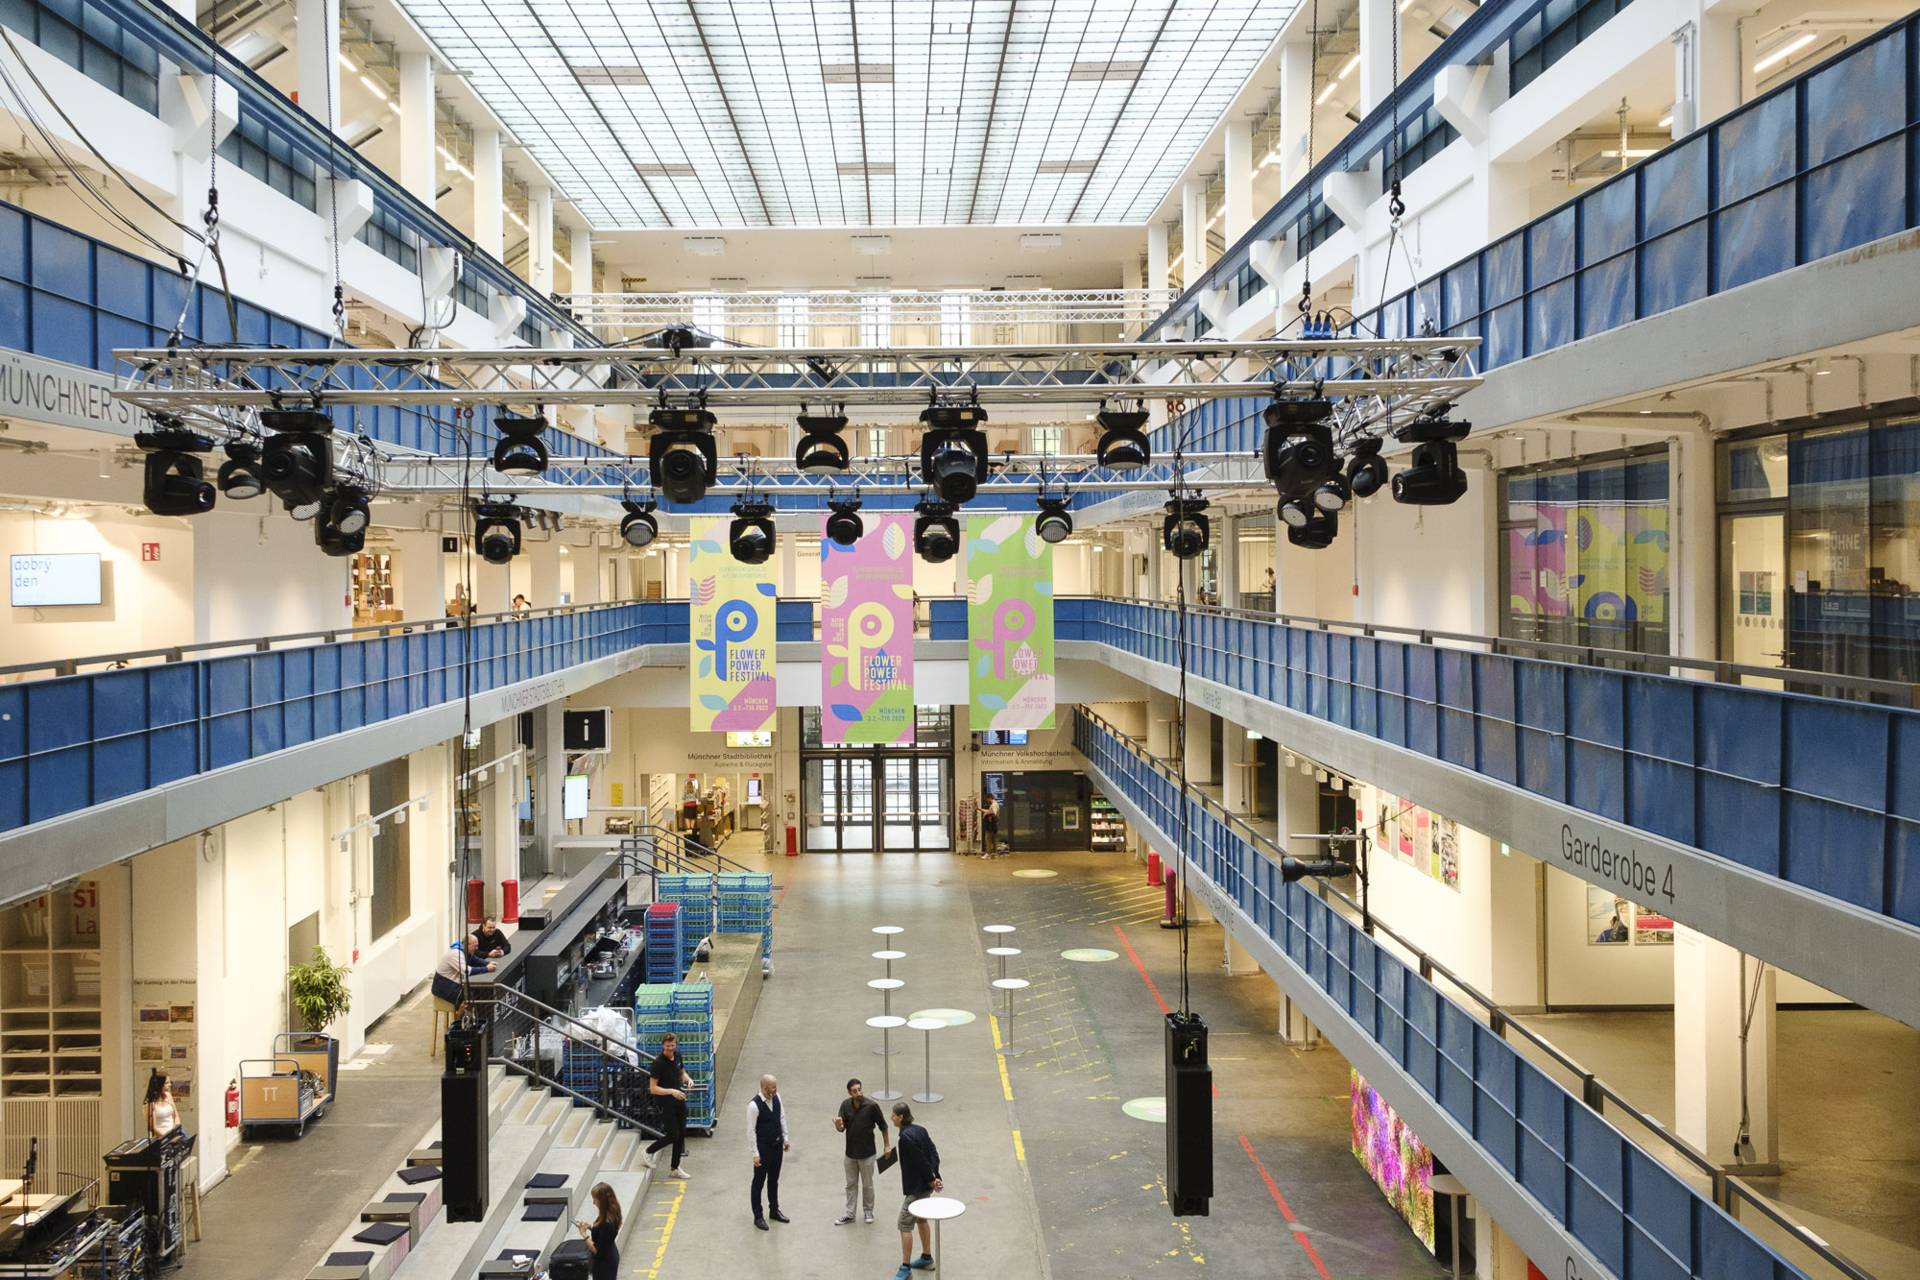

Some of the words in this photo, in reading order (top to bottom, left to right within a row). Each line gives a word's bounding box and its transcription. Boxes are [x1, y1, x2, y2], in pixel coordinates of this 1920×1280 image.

[14, 572, 39, 587] den
[730, 649, 766, 659] FLOWER
[730, 661, 761, 670] POWER
[864, 655, 902, 667] FLOWER
[730, 672, 771, 681] FESTIVAL
[864, 667, 898, 679] POWER
[864, 679, 908, 691] FESTIVAL
[688, 752, 720, 760] Münchner
[722, 752, 772, 760] Stadtbibliothek
[1561, 823, 1655, 896] Garderobe
[1662, 864, 1675, 904] 4
